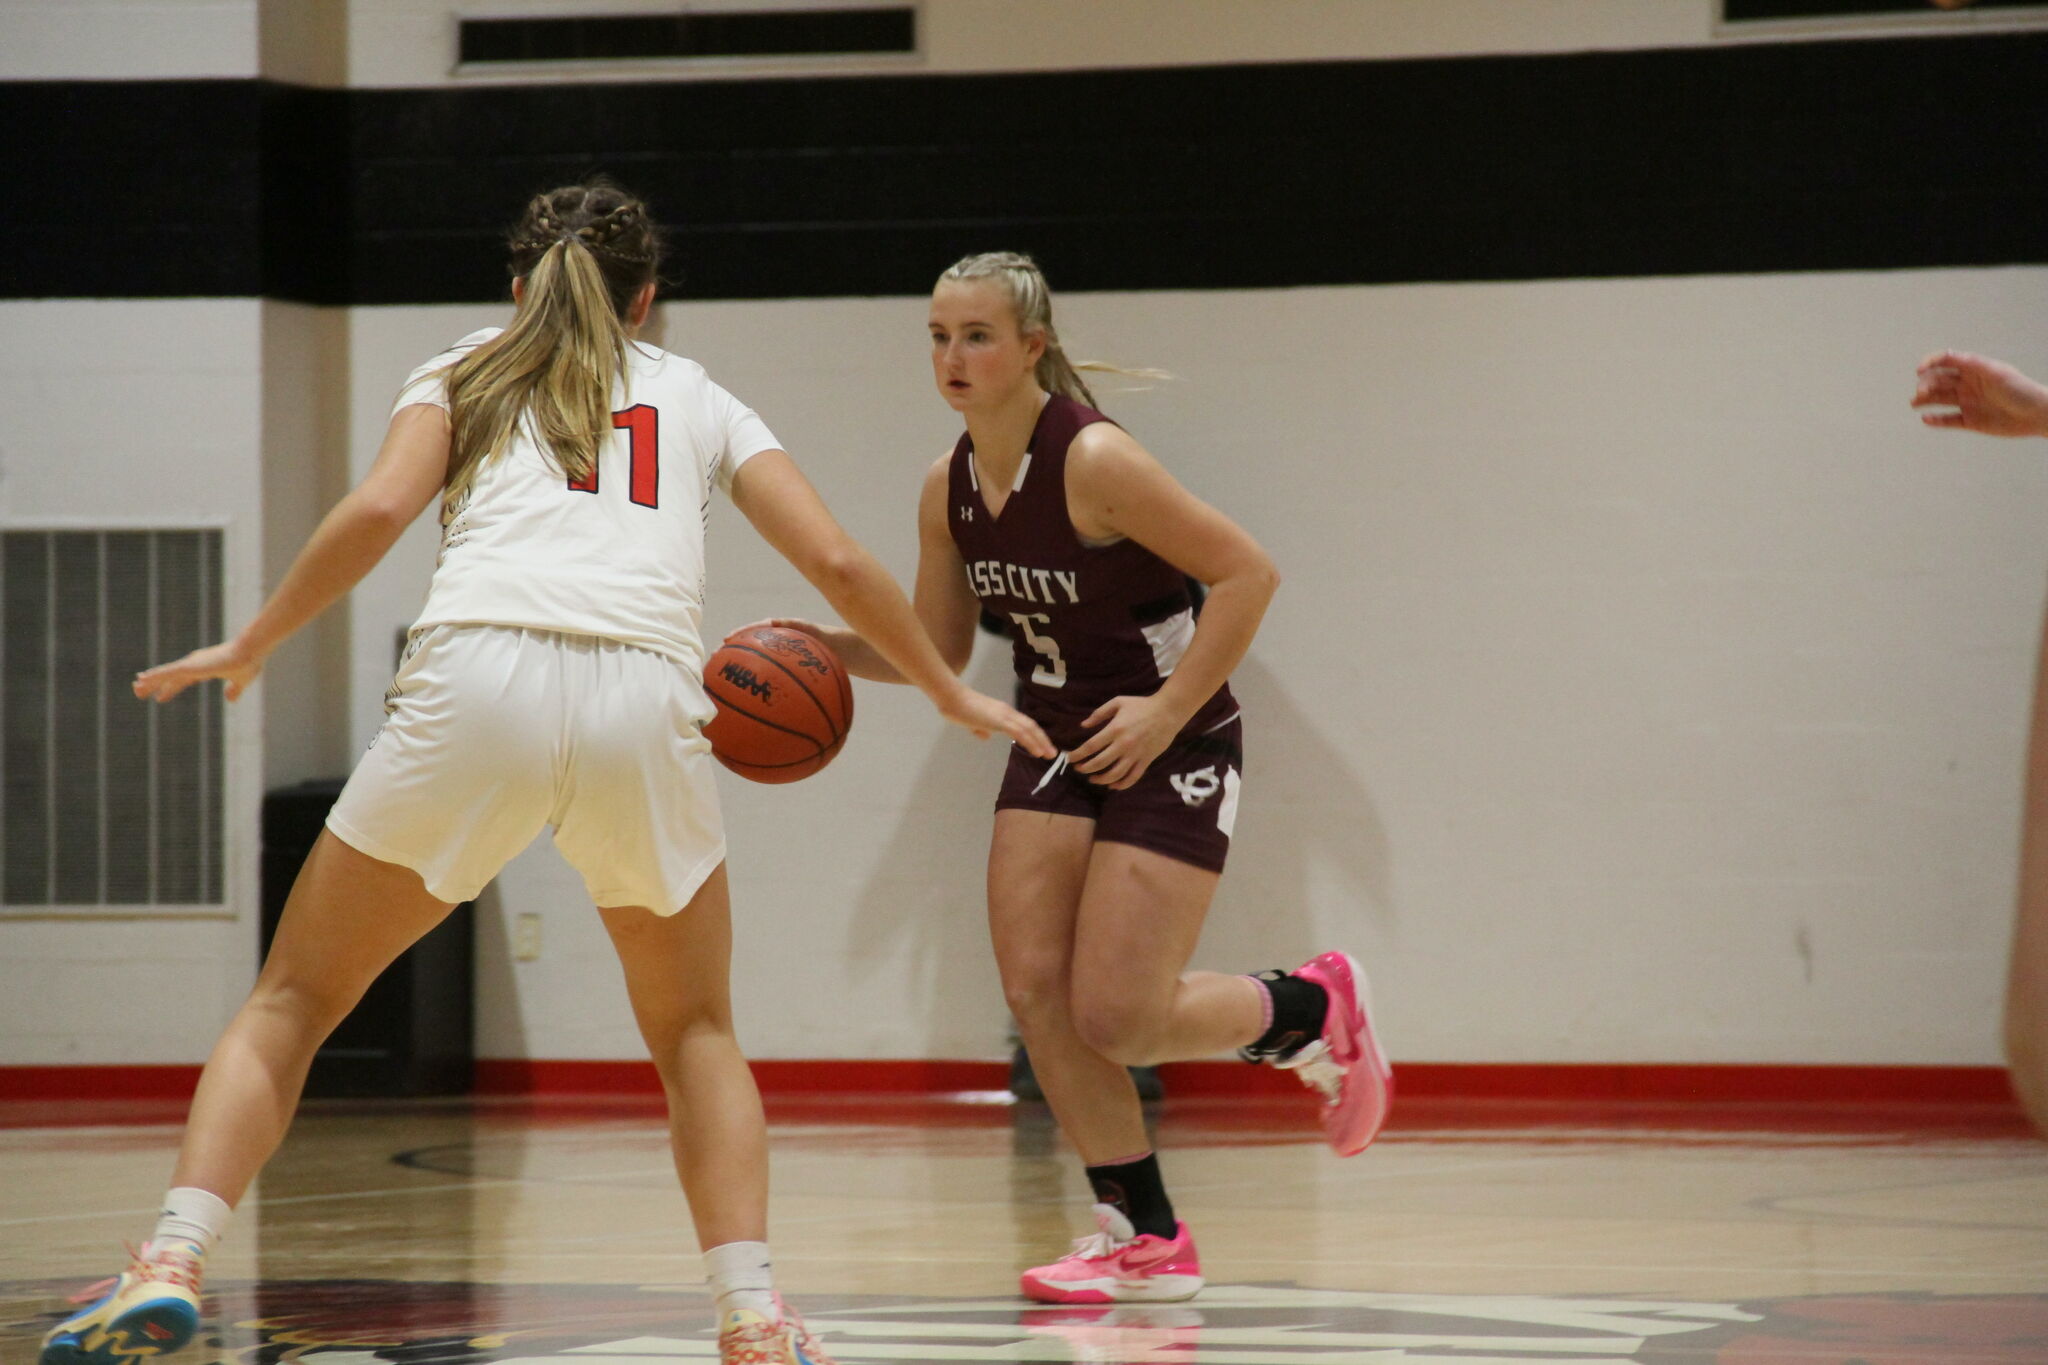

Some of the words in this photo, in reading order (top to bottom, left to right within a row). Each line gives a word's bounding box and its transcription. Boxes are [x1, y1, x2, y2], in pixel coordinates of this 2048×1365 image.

[567, 403, 659, 510] 1
[966, 561, 1006, 597] ASS
[1006, 563, 1080, 604] CITY
